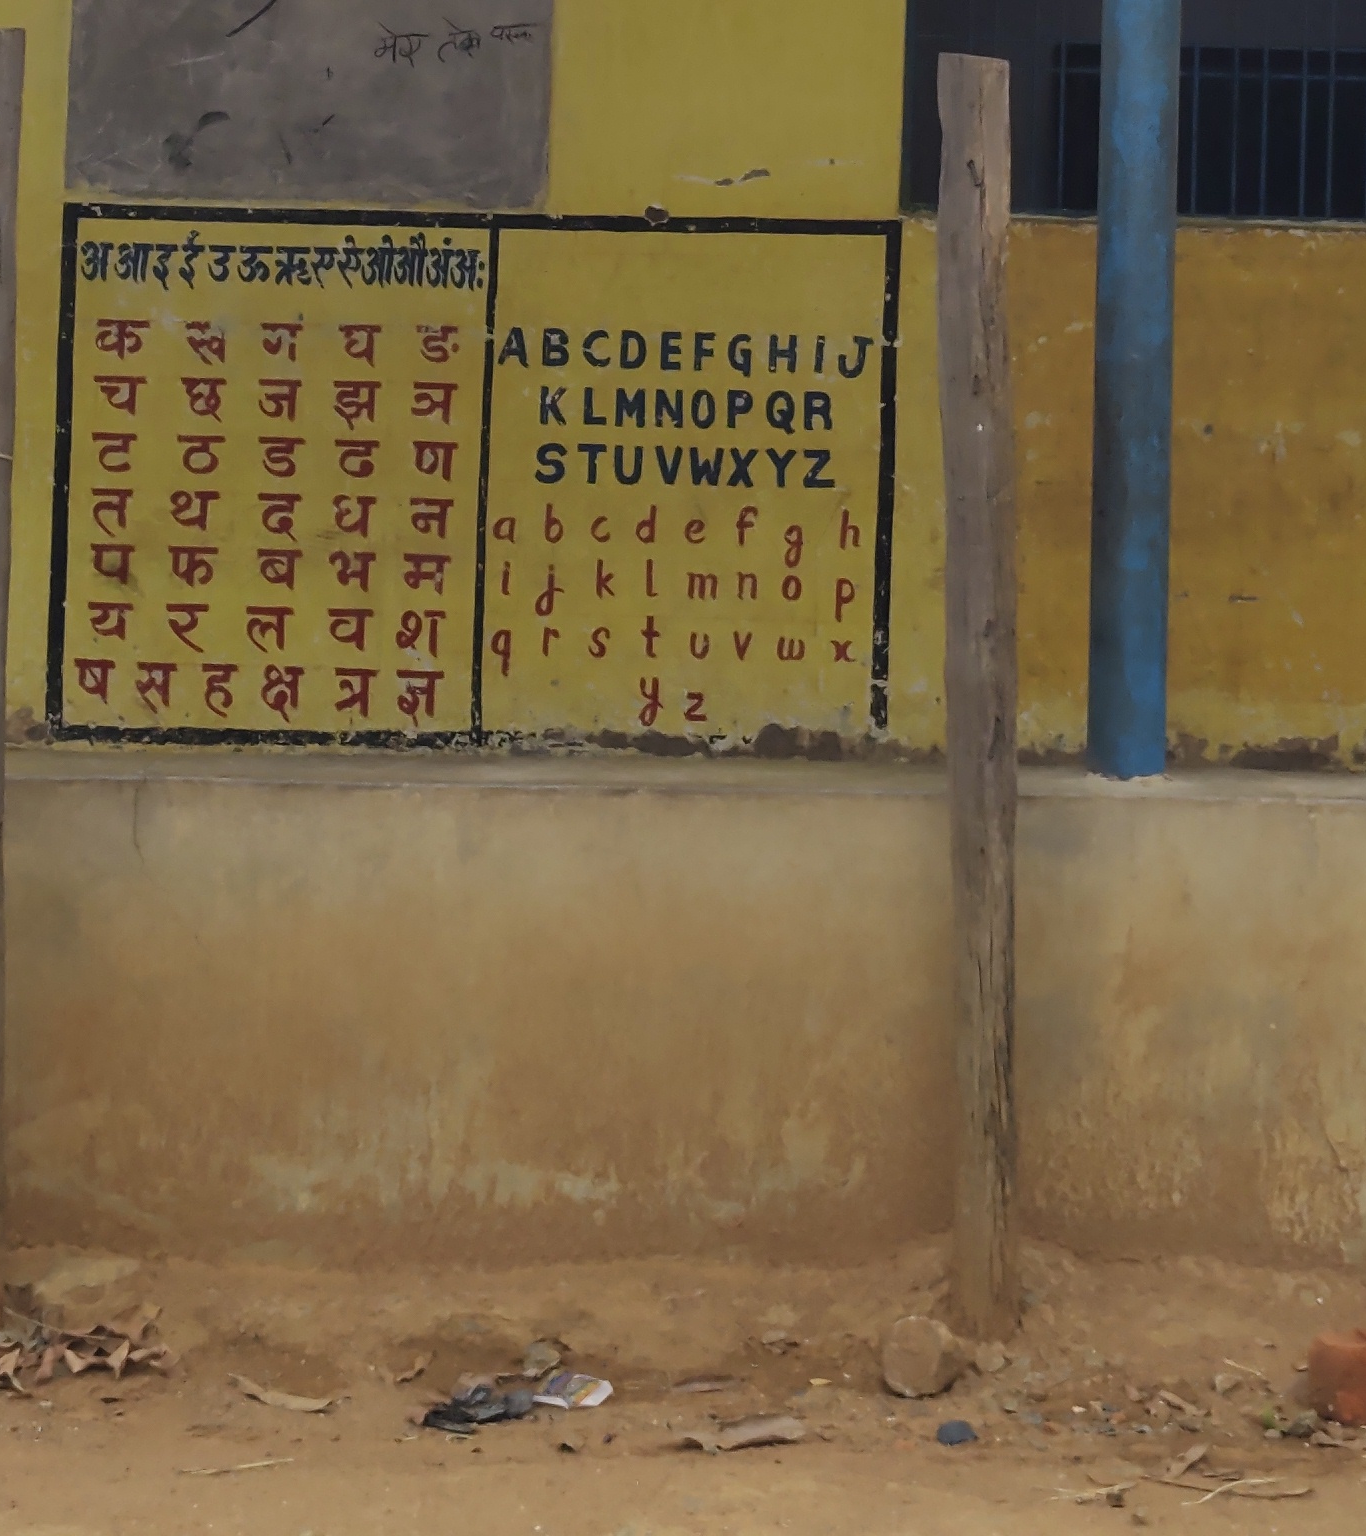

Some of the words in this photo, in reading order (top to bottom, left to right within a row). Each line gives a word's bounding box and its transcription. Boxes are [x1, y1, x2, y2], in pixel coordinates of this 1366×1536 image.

[94, 317, 152, 361] क
[184, 320, 227, 366] ख
[259, 321, 305, 362] ग
[338, 323, 384, 368] घ
[92, 374, 148, 417] च
[180, 375, 228, 423] छ
[258, 377, 304, 423] ज
[332, 379, 383, 432] झ
[90, 430, 139, 474] ट
[175, 433, 227, 476] ठ
[257, 435, 308, 479] ड
[334, 438, 381, 479] ढ
[412, 439, 460, 482] ण
[90, 487, 135, 539] त
[169, 489, 222, 533] थ
[256, 491, 304, 544] द
[331, 493, 379, 539] ध
[409, 496, 455, 540] न
[89, 542, 138, 586] प
[166, 543, 220, 588] फ
[255, 547, 305, 591] ब
[327, 549, 378, 594] भ
[401, 551, 454, 596] म
[86, 600, 137, 641] य
[164, 602, 211, 654] र
[244, 604, 296, 654] ल
[326, 606, 377, 653] व
[394, 608, 448, 658] श
[73, 657, 117, 705] ष
[134, 661, 179, 715] स
[199, 662, 241, 720] ह
[259, 663, 306, 725] क्ष
